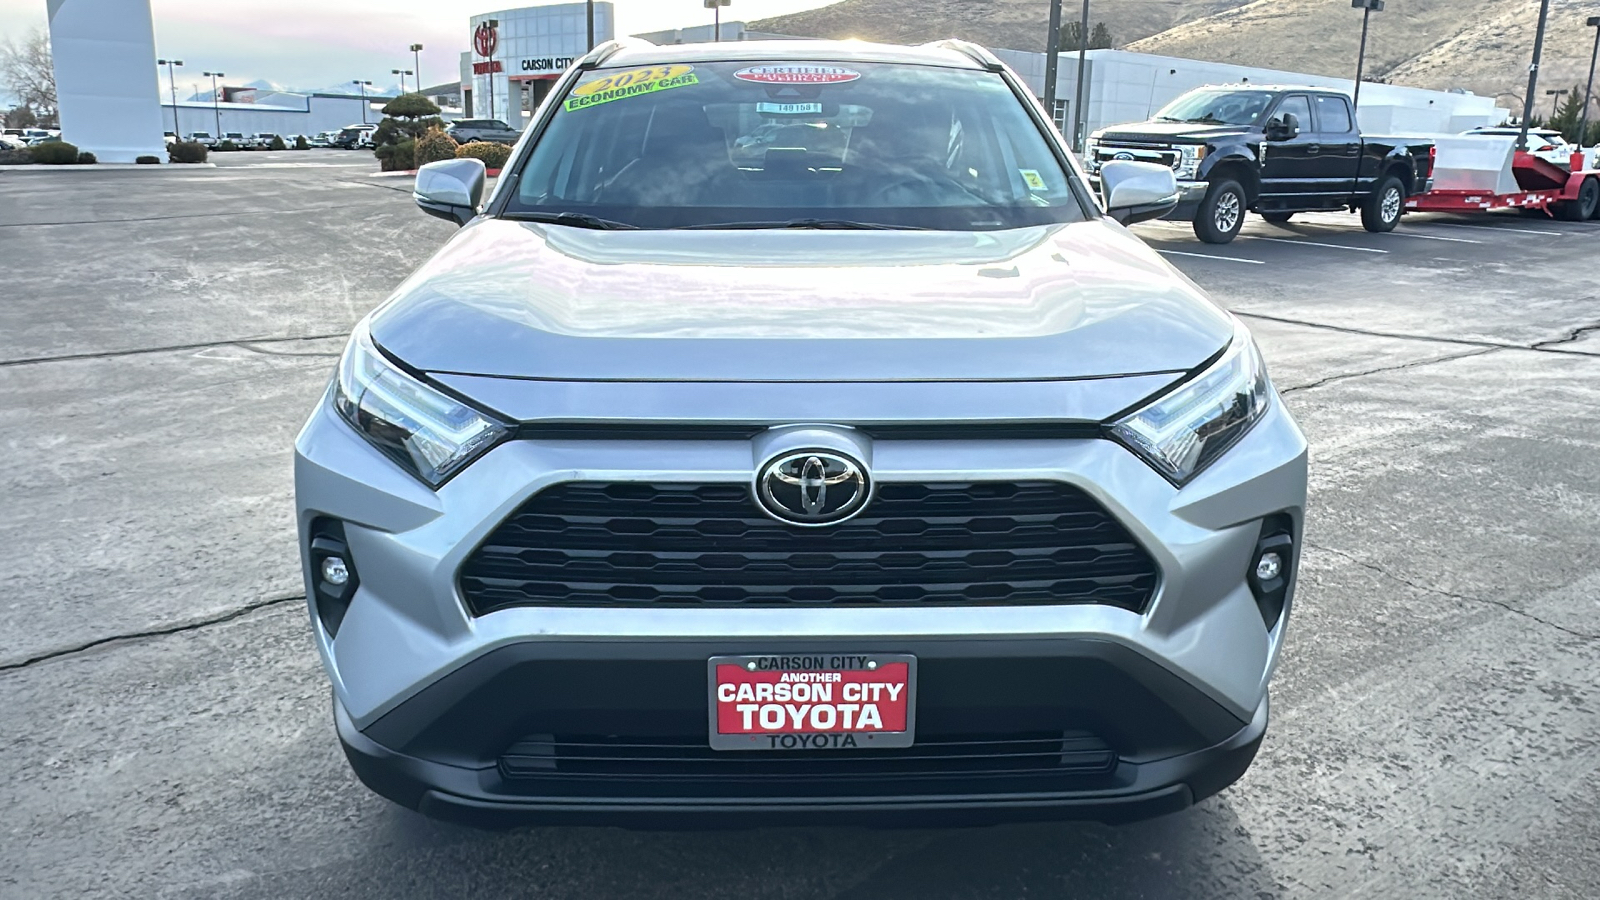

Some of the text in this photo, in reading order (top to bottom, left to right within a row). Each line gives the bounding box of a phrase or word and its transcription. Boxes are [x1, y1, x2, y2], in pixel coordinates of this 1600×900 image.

[521, 57, 575, 71] CARSON CITY
[594, 66, 672, 92] 2023
[568, 75, 695, 109] ECONOMY CAR
[757, 656, 868, 671] CARSON CITY
[780, 672, 842, 683] ANOTHER
[717, 682, 905, 703] CARSON CITY
[736, 703, 884, 730] TOYOTA
[766, 734, 858, 749] TOYOTA
